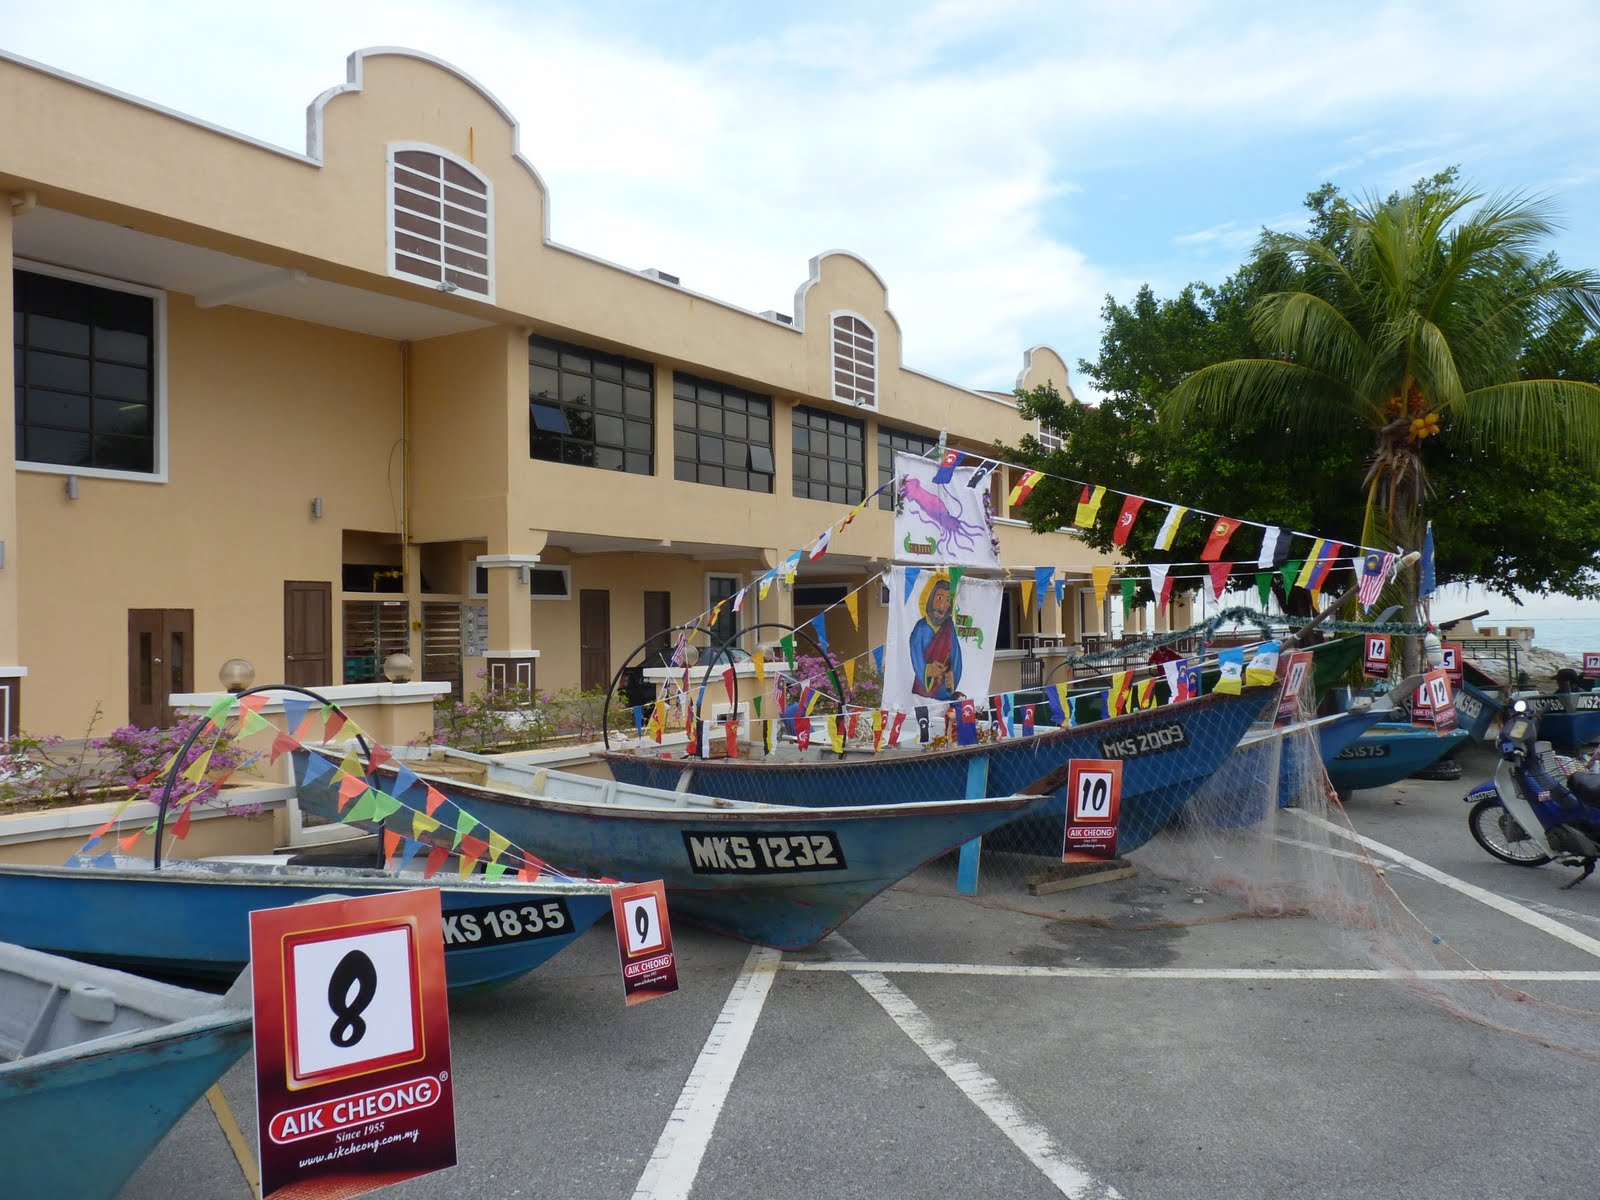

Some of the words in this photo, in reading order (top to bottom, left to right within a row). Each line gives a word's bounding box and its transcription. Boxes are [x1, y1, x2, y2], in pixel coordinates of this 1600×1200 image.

[958, 627, 977, 637] PETER
[1372, 641, 1384, 656] 14
[1443, 651, 1453, 666] 5
[1588, 657, 1599, 666] 17
[1289, 667, 1303, 691] 11
[1434, 680, 1446, 704] 12
[1103, 738, 1138, 758] MKS
[1137, 725, 1184, 751] 2009
[1082, 777, 1107, 811] 10
[1083, 829, 1112, 837] CHEONG
[690, 836, 756, 869] MKS
[757, 835, 838, 868] 1232
[441, 913, 482, 944] KS
[483, 902, 565, 938] 1835
[635, 905, 649, 944] 9
[628, 965, 640, 975] AIK
[641, 957, 669, 971] CHEONG
[328, 949, 377, 1048] 8
[281, 1108, 324, 1138] AIK
[332, 1082, 432, 1124] CHEONG
[335, 1129, 362, 1143] Since
[363, 1121, 385, 1138] 1955
[299, 1128, 419, 1168] www.aikcheong.com.my
